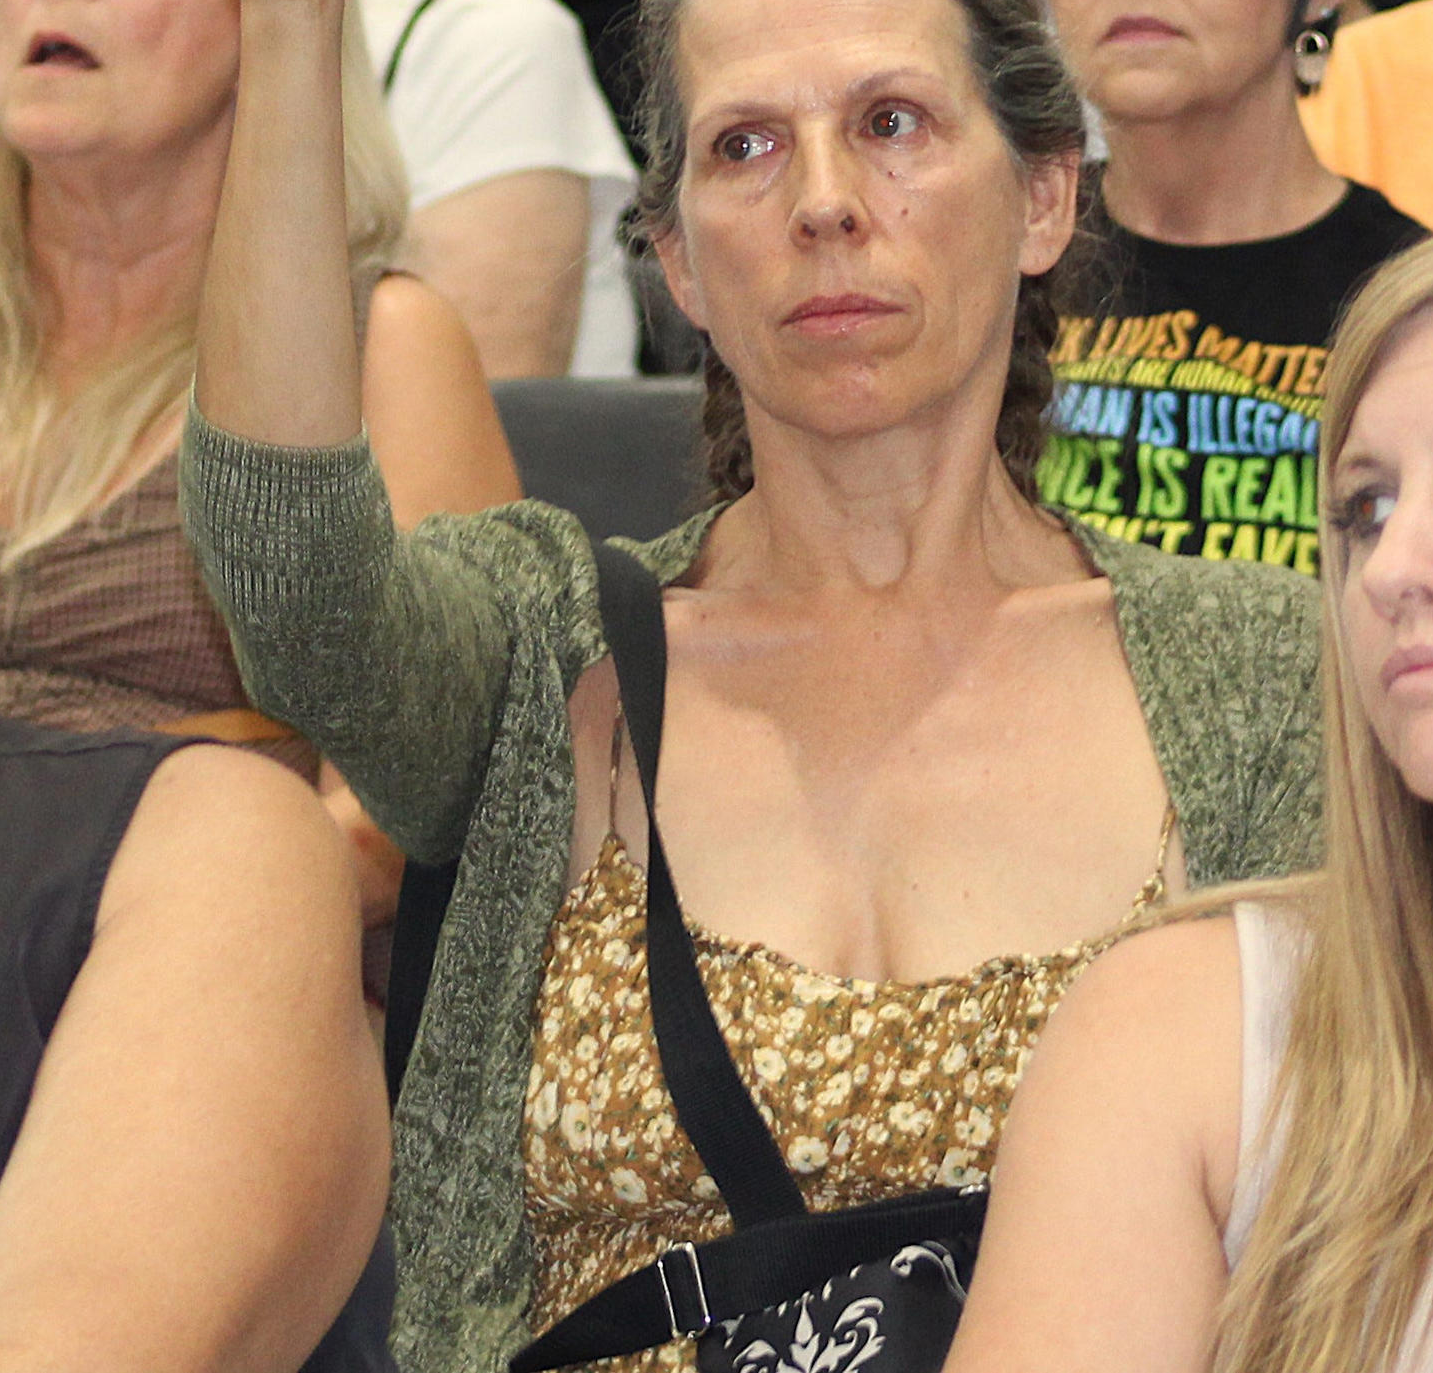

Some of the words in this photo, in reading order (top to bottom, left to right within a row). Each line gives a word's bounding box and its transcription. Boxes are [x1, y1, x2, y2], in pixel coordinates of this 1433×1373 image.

[1088, 309, 1200, 361] LIVES
[1194, 324, 1329, 395] MATTE
[1135, 390, 1179, 448] IS
[1136, 442, 1189, 518] IS
[1200, 454, 1320, 528] REAL
